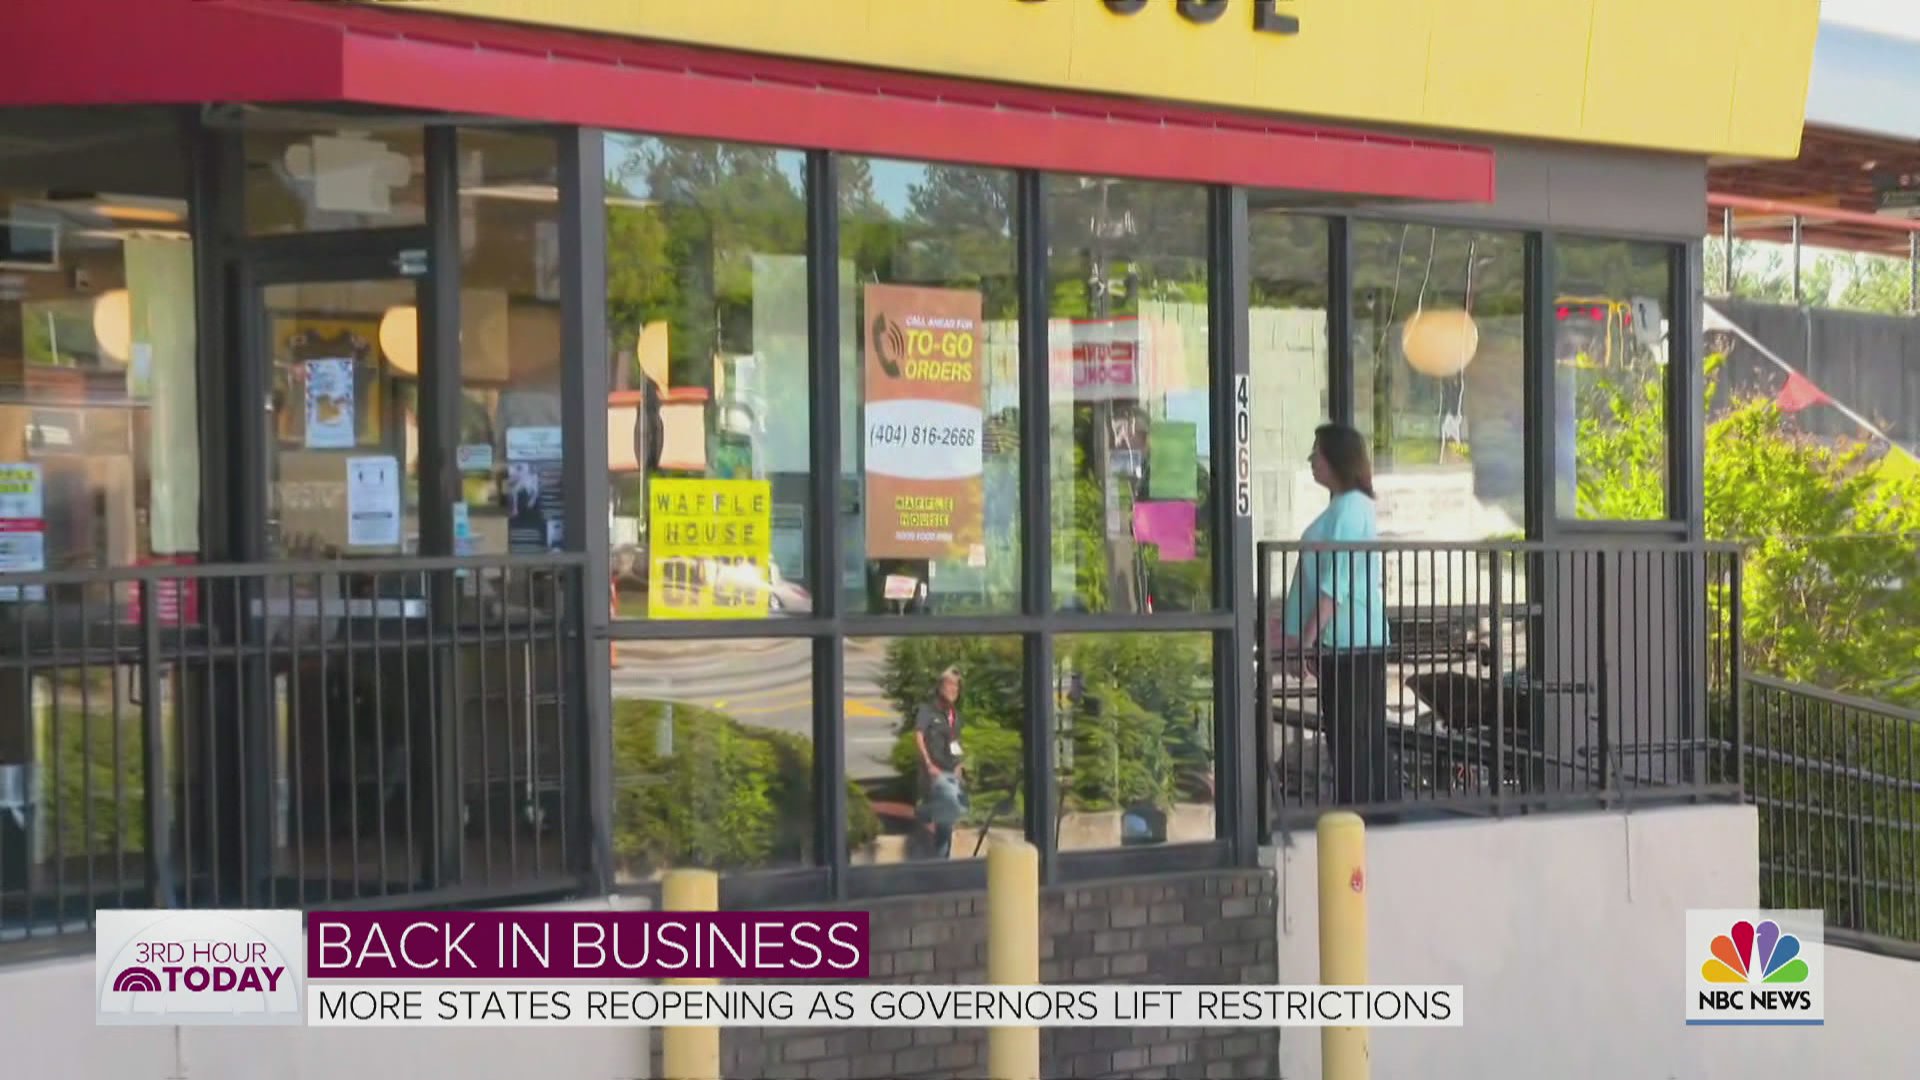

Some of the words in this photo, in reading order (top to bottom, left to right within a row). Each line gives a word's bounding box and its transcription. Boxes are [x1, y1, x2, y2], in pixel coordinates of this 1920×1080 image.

[906, 329, 973, 359] TO-GO
[905, 360, 972, 382] ORDERS
[870, 424, 907, 448] (404)
[1237, 376, 1249, 515] 4065
[657, 493, 763, 516] WAFFLE
[664, 522, 755, 546] HOUSE
